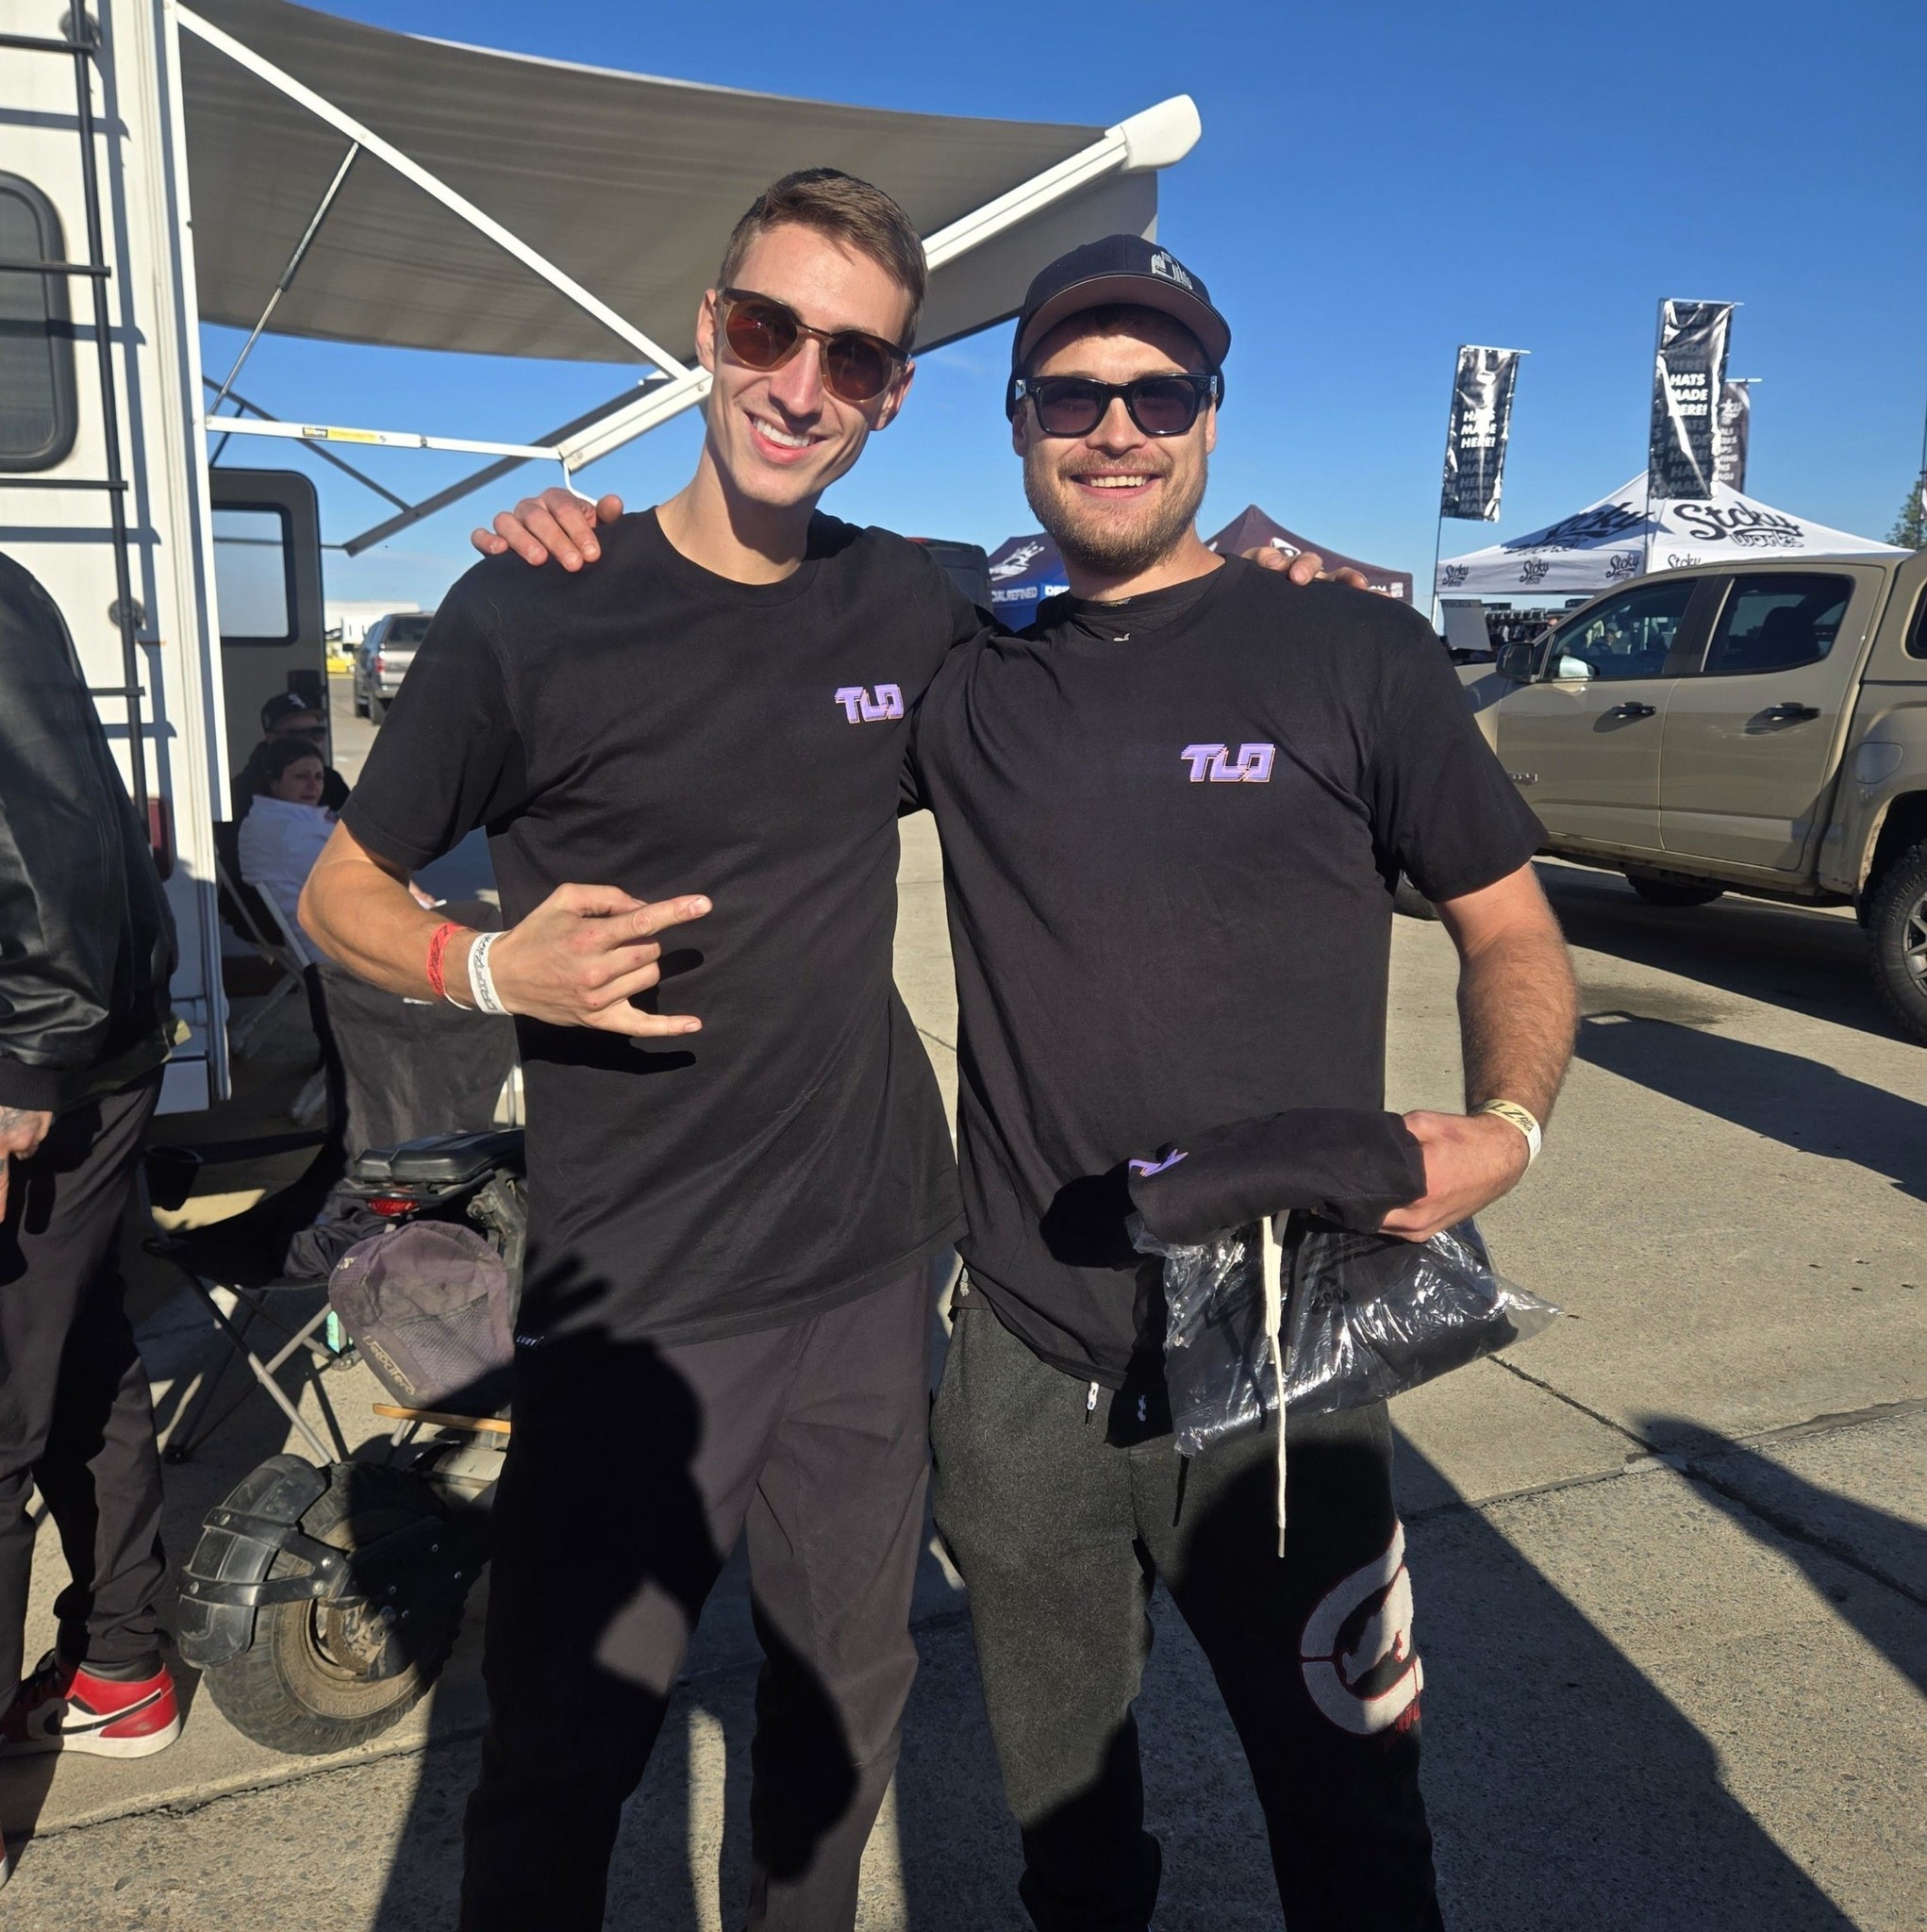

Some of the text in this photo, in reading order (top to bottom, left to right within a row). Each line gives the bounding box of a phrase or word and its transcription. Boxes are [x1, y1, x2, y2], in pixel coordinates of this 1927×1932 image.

[1670, 374, 1705, 386] HATS
[1463, 410, 1496, 422] HAS
[1673, 404, 1707, 416] ERE!
[1461, 424, 1497, 435] MAE
[1458, 502, 1487, 514] MAD
